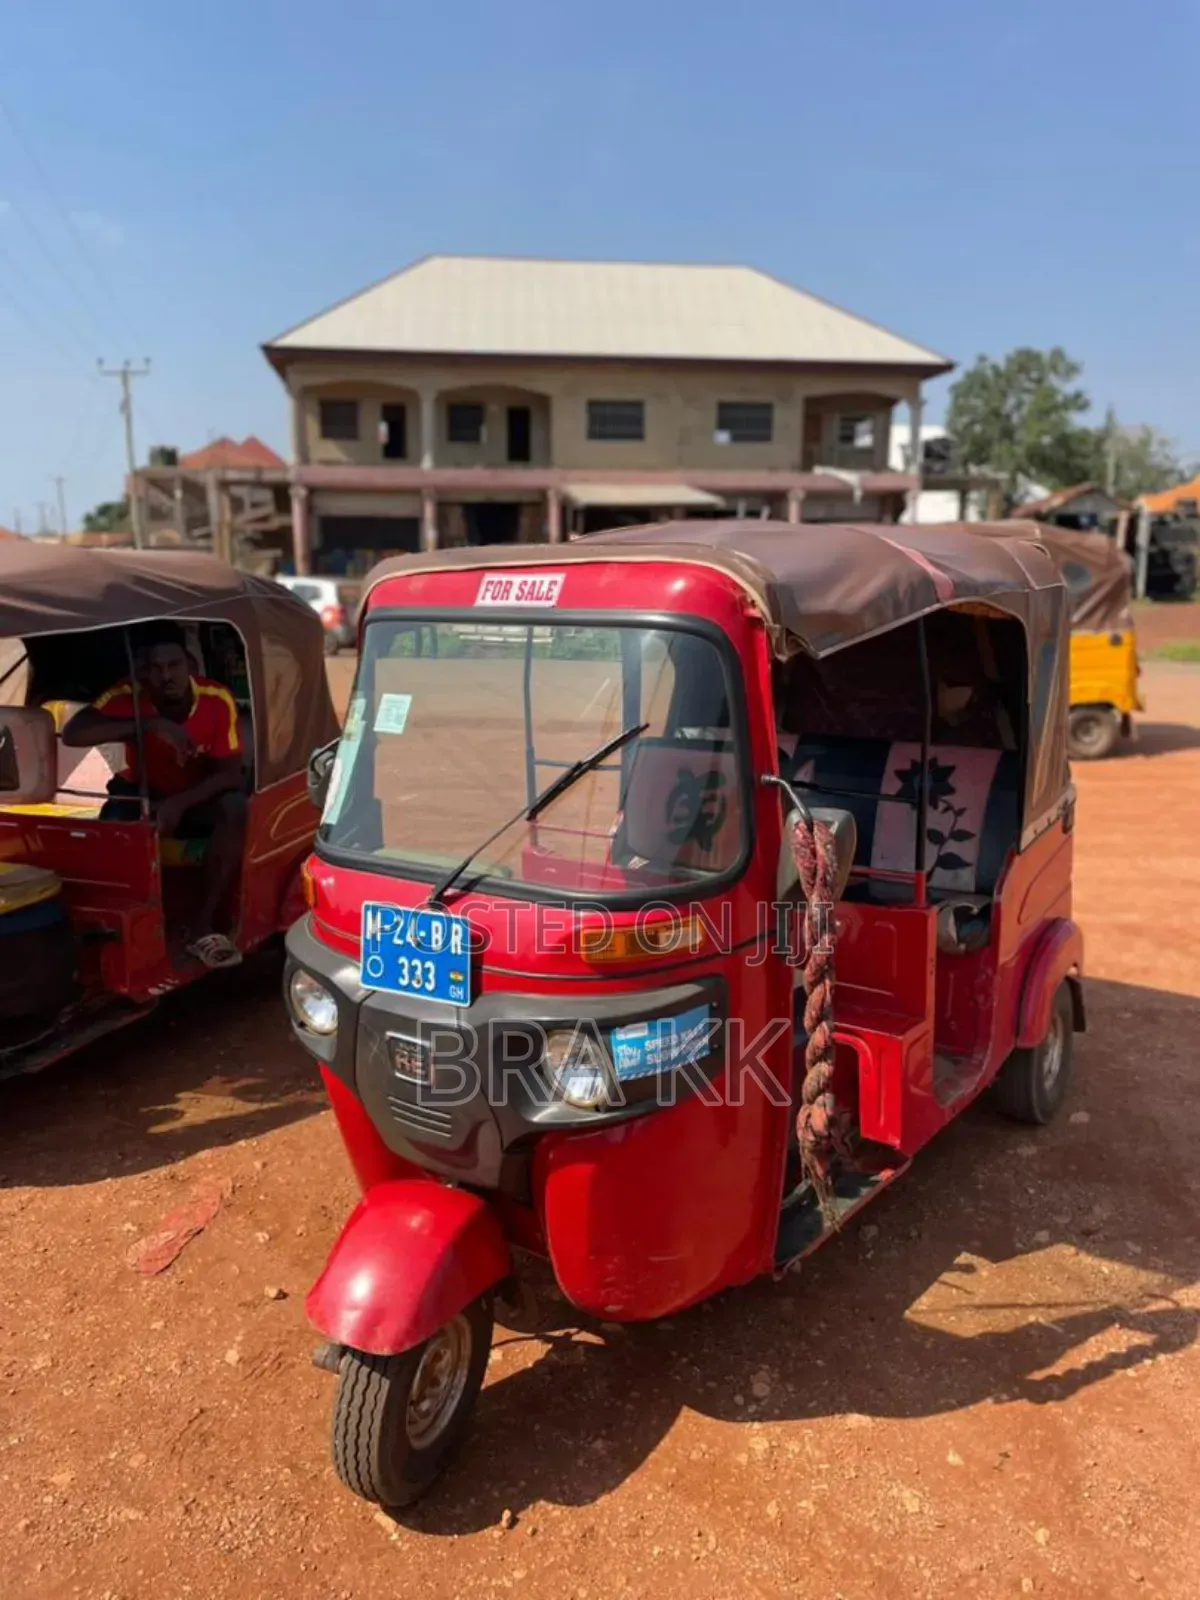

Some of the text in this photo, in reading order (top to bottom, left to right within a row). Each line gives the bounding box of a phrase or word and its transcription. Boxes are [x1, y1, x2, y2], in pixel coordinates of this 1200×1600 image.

[481, 579, 558, 601] FOR SALE
[397, 956, 436, 992] 333
[448, 984, 465, 1001] GH
